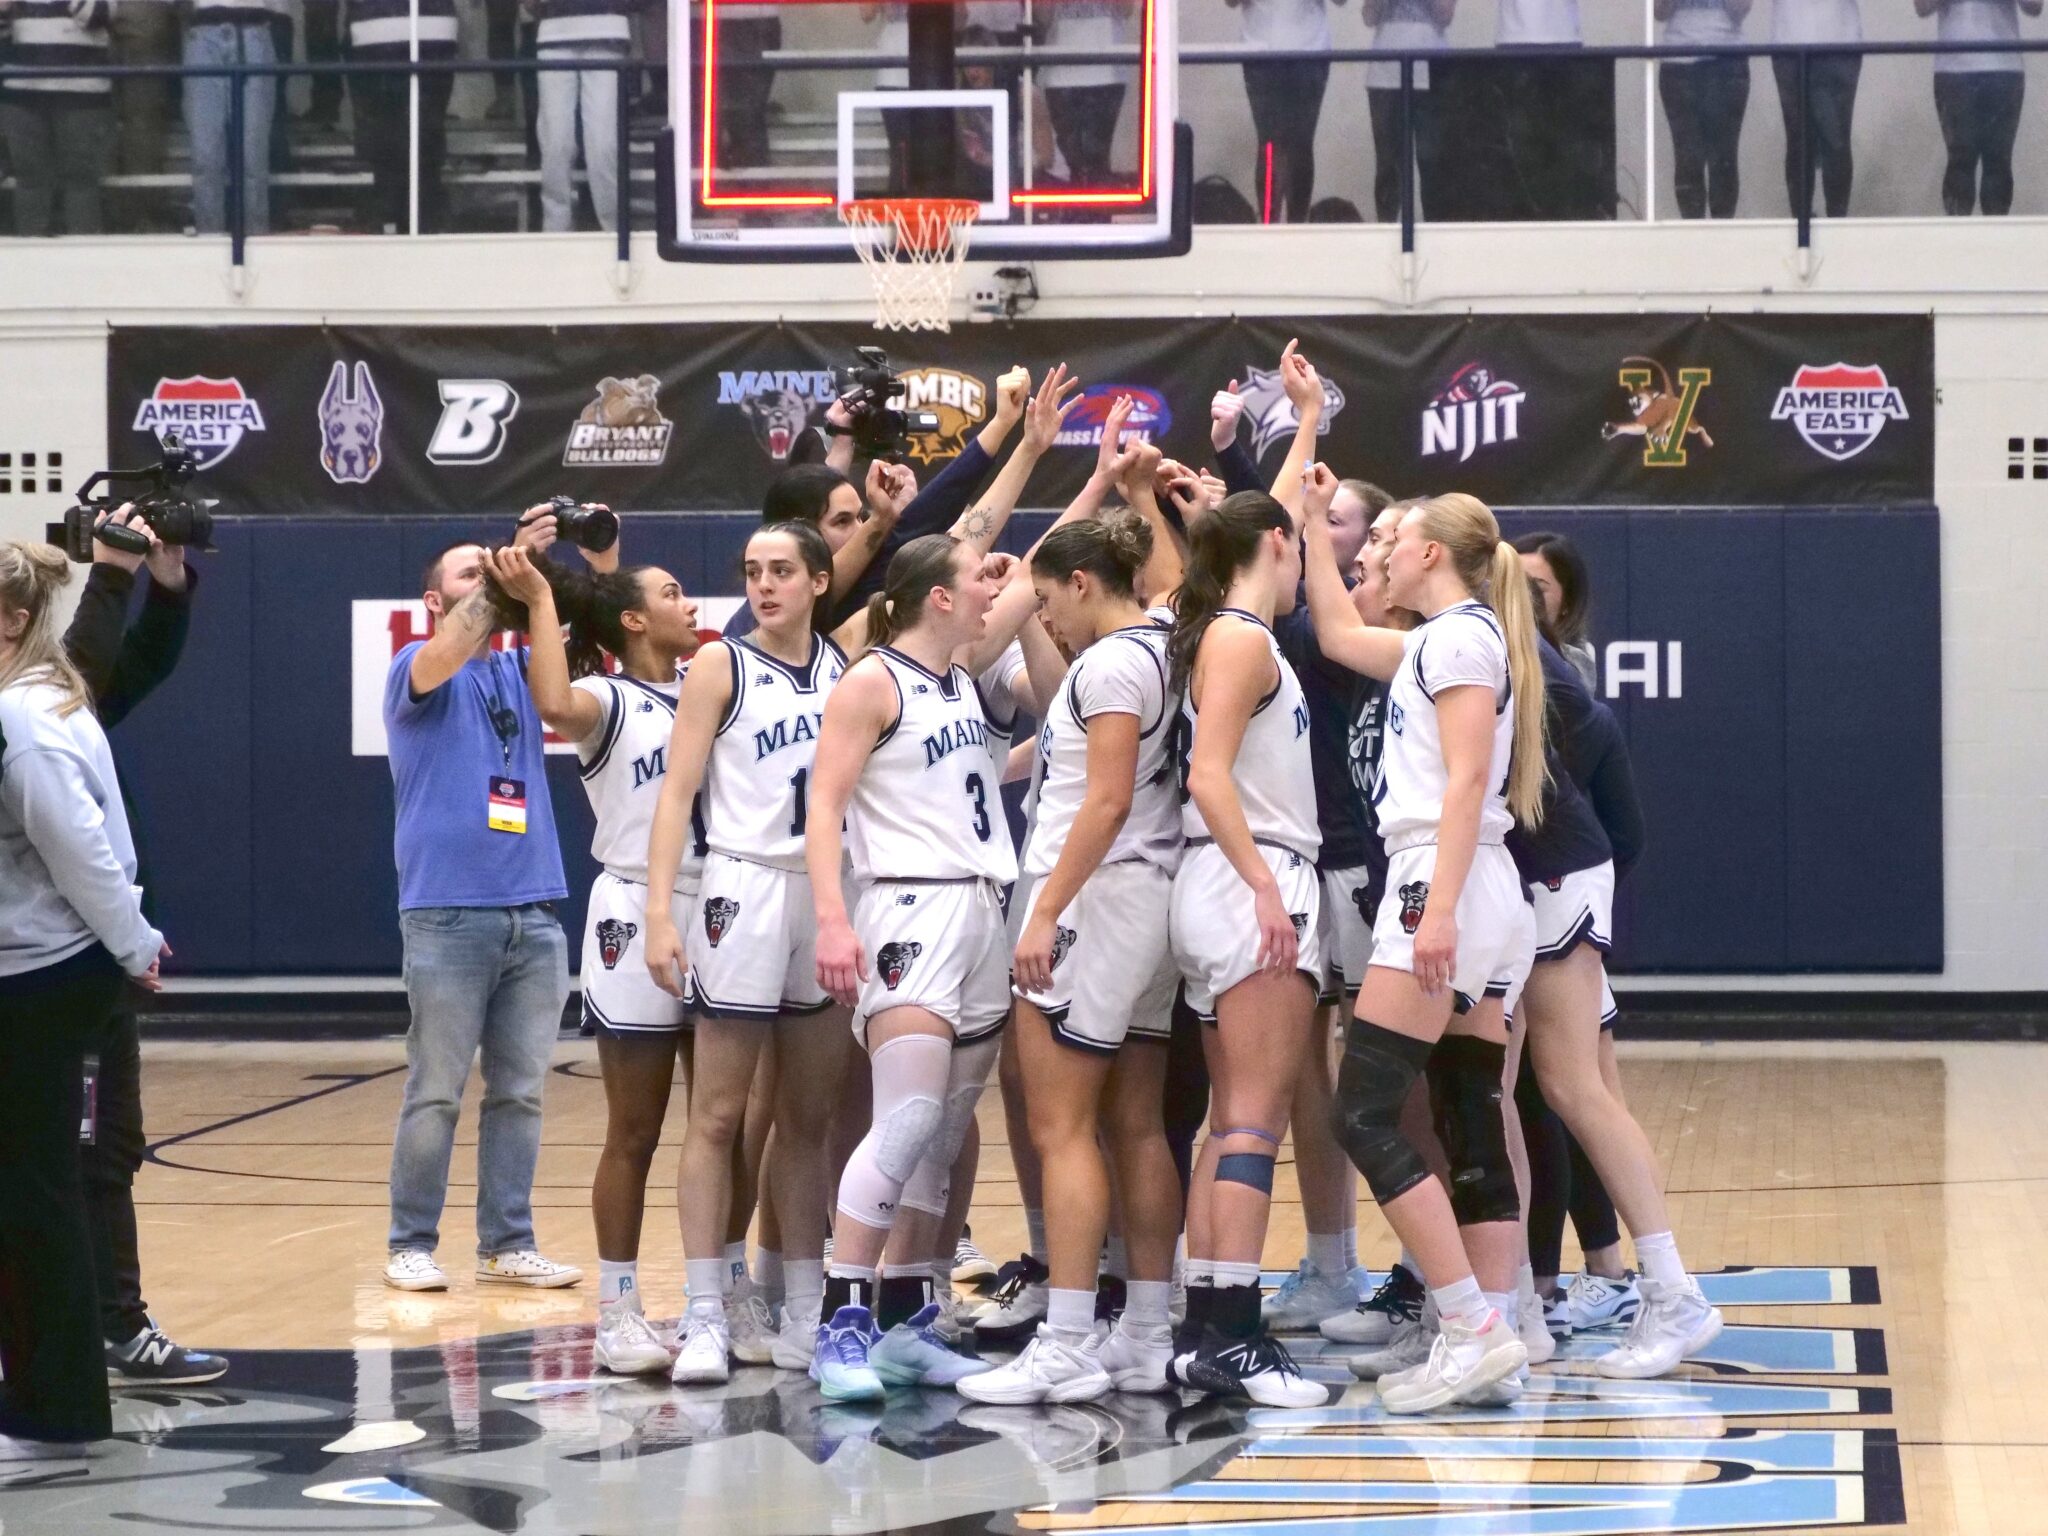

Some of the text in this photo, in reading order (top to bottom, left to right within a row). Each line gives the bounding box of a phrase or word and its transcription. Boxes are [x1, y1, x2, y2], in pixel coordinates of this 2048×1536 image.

[717, 370, 837, 404] MAINE
[1778, 391, 1902, 414] AMERICA
[139, 403, 259, 426] AMERICA
[164, 424, 232, 440] EAST
[426, 379, 519, 465] B
[1420, 391, 1526, 462] NJIT
[1805, 412, 1875, 430] EAST
[568, 449, 662, 462] BULLDOGS
[572, 424, 668, 449] BRYANT
[1586, 640, 1682, 699] AI
[752, 712, 824, 764] MAI
[920, 718, 992, 772] MAIN
[788, 766, 808, 839] 1
[964, 770, 992, 844] 3
